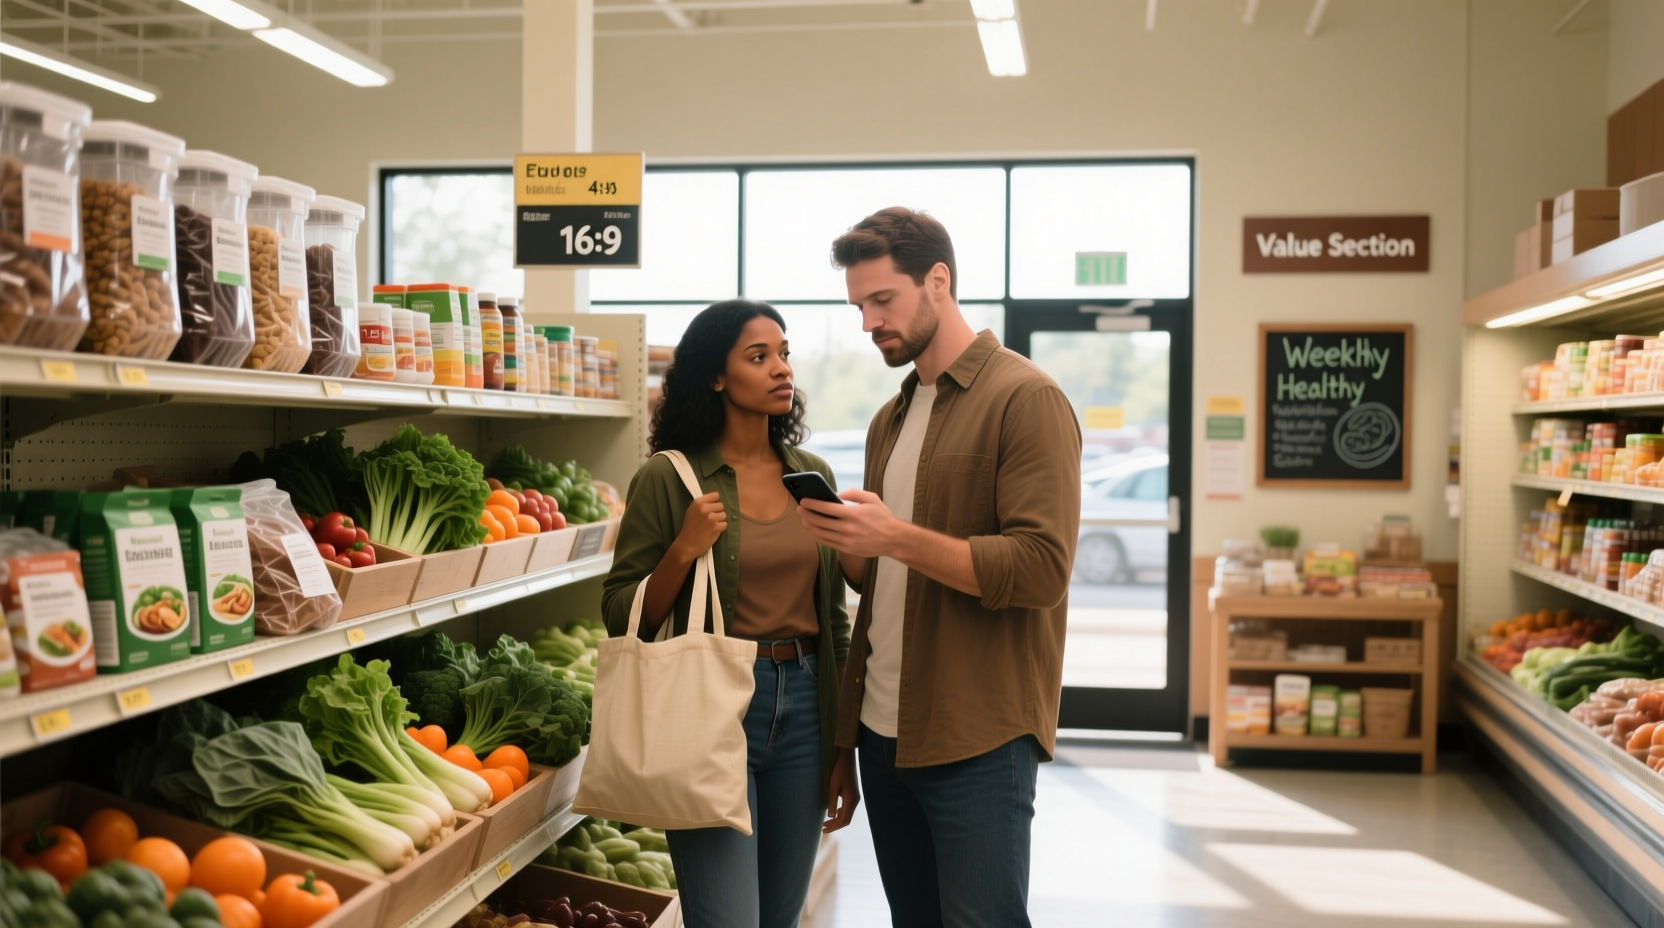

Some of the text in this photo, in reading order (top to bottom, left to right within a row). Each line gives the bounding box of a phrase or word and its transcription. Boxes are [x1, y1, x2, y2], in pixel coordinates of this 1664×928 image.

[560, 224, 622, 255] 16:9
[1256, 232, 1415, 258] Value Section
[1277, 371, 1366, 408] Healthy
